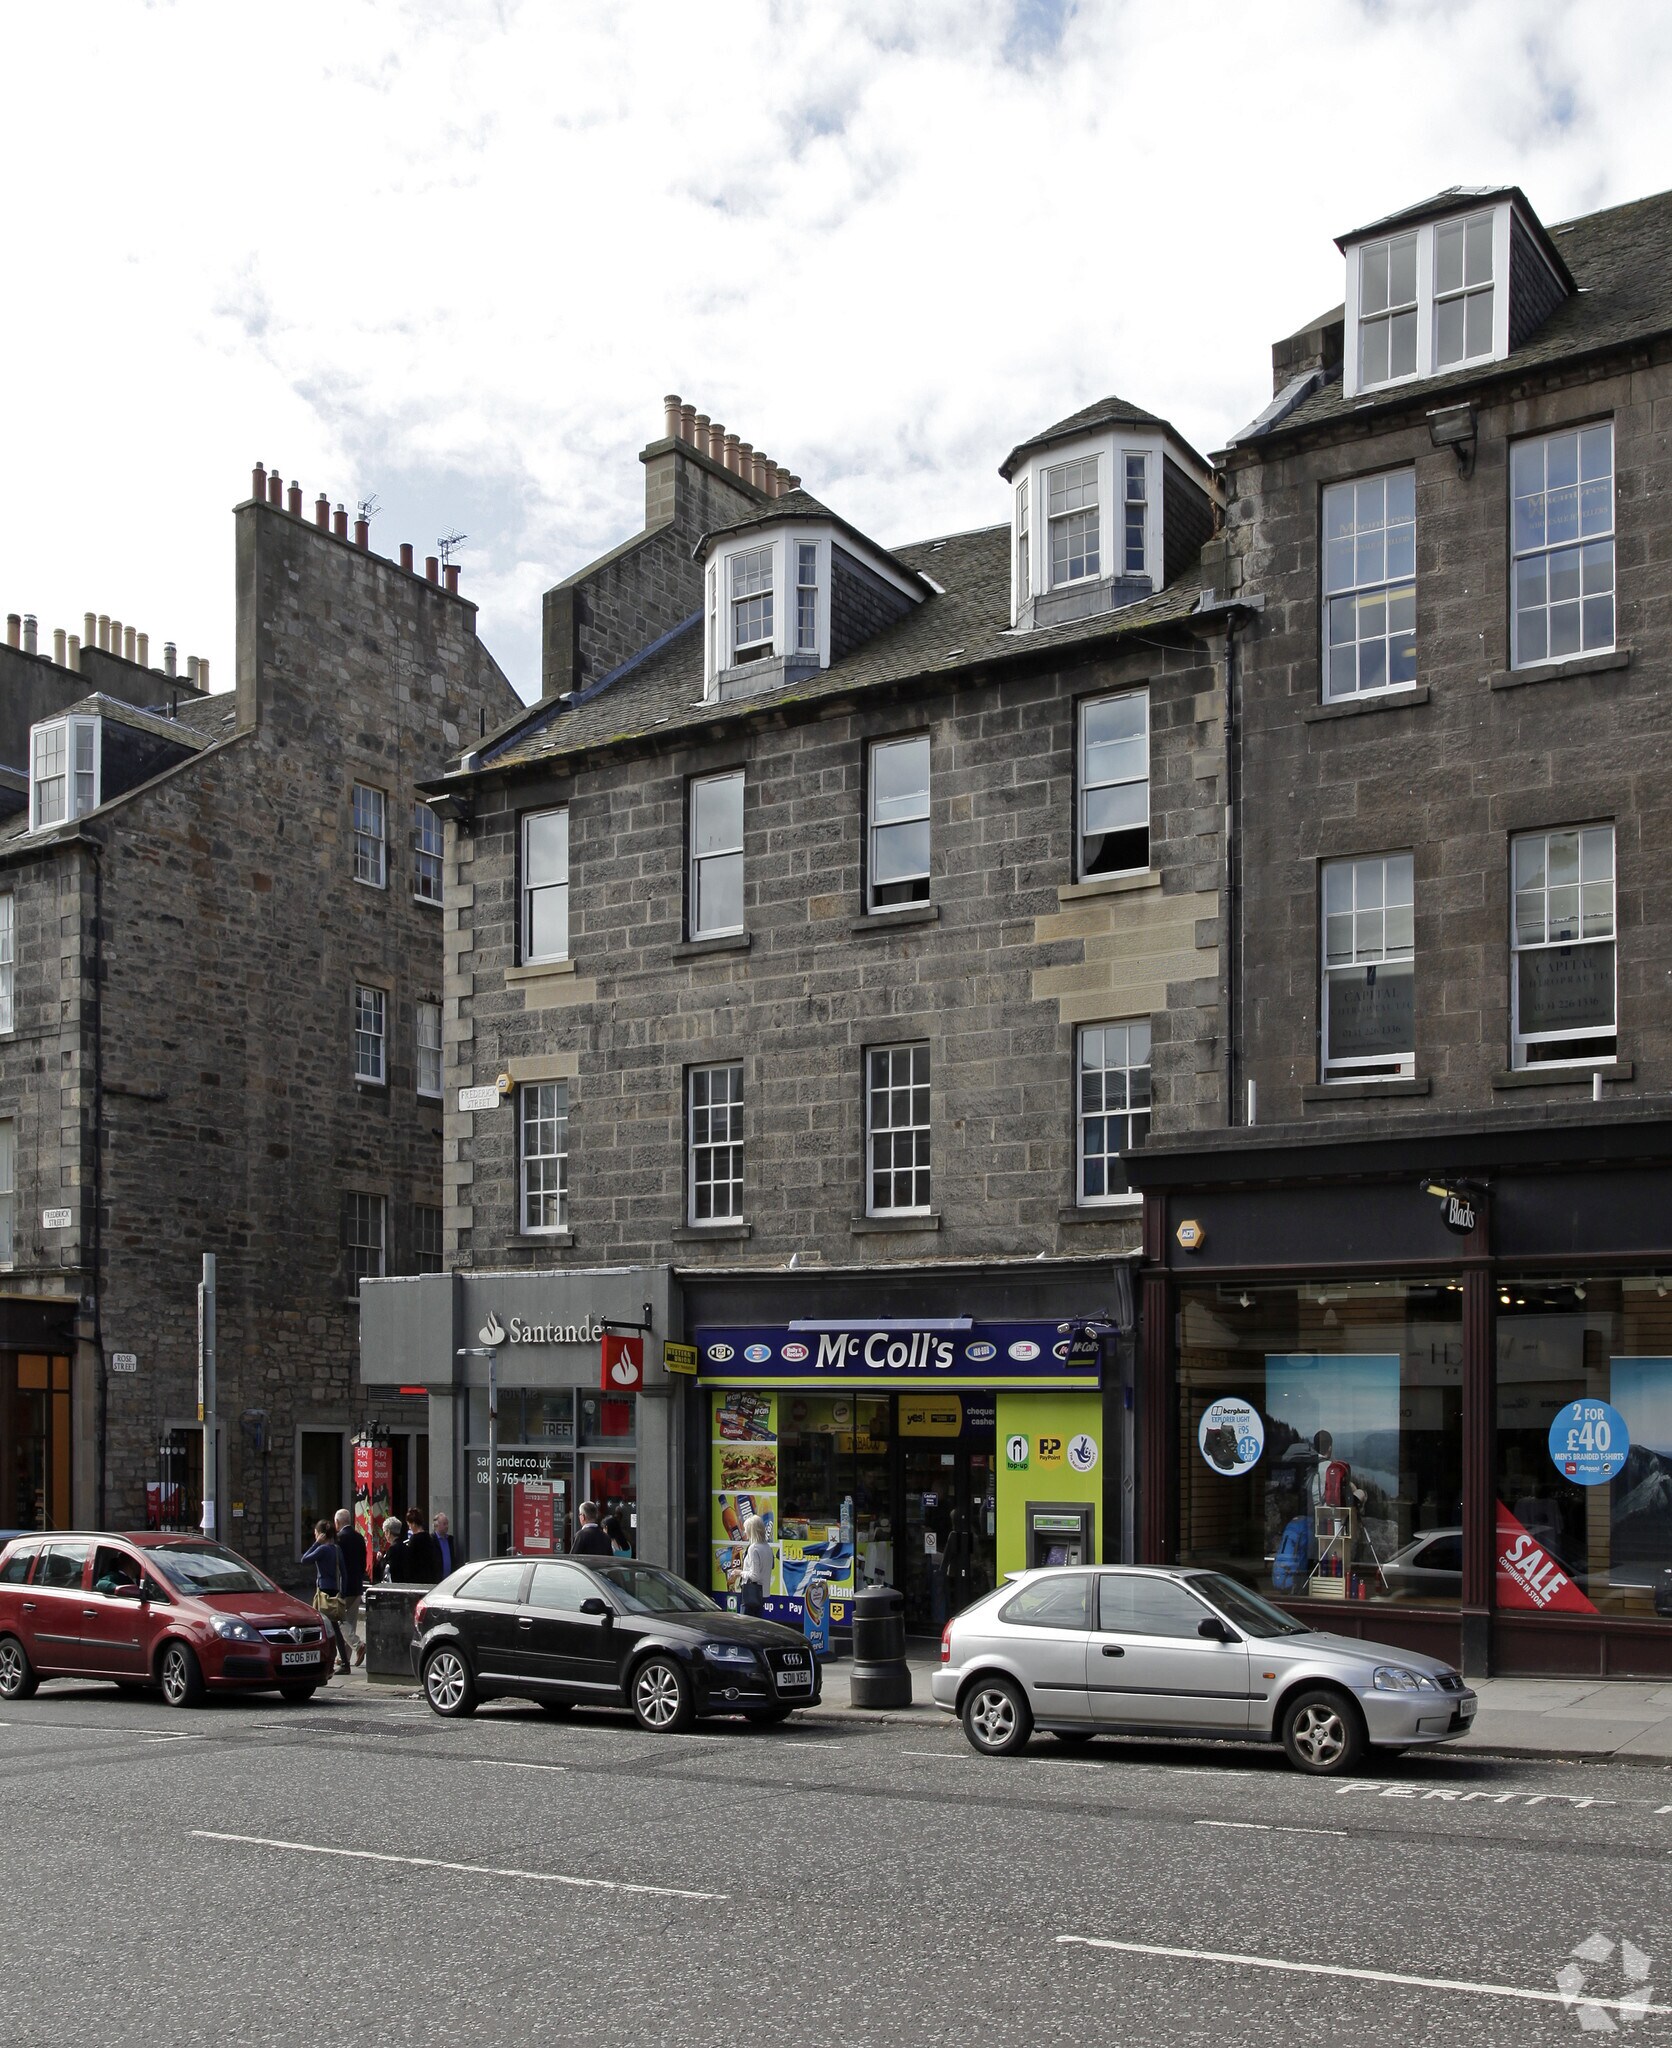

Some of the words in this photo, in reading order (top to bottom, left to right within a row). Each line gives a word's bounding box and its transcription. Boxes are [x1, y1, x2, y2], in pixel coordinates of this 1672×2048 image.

[1340, 514, 1411, 534] Macintres
[1536, 958, 1598, 974] CAPITAL
[1344, 987, 1399, 1002] CAPITAL
[461, 1088, 498, 1100] FREDERICK
[467, 1098, 491, 1109] STREET
[45, 1210, 70, 1218] FREDERICK
[1449, 1197, 1475, 1228] Blacks
[1182, 1230, 1194, 1238] ADT
[815, 1332, 954, 1368] McColl's
[117, 1354, 132, 1363] ROSE
[114, 1362, 135, 1370] STREET
[907, 1412, 925, 1425] yes!
[1573, 1404, 1582, 1420] 2
[1585, 1408, 1604, 1420] FOR
[1567, 1421, 1611, 1451] £40
[1240, 1439, 1256, 1454] £15
[477, 1455, 551, 1469] sanander.co.uk
[477, 1472, 499, 1484] 085
[502, 1472, 518, 1485] 765
[521, 1473, 544, 1486] 4321
[785, 1547, 803, 1560] 100
[1505, 1535, 1568, 1603] SALE
[1499, 1556, 1524, 1589] CONTINUES
[1529, 1590, 1545, 1608] STORE
[829, 1584, 855, 1597] tland
[811, 1631, 822, 1641] Play
[305, 1651, 319, 1661] BVK
[1335, 1784, 1616, 1808] PERMIT
